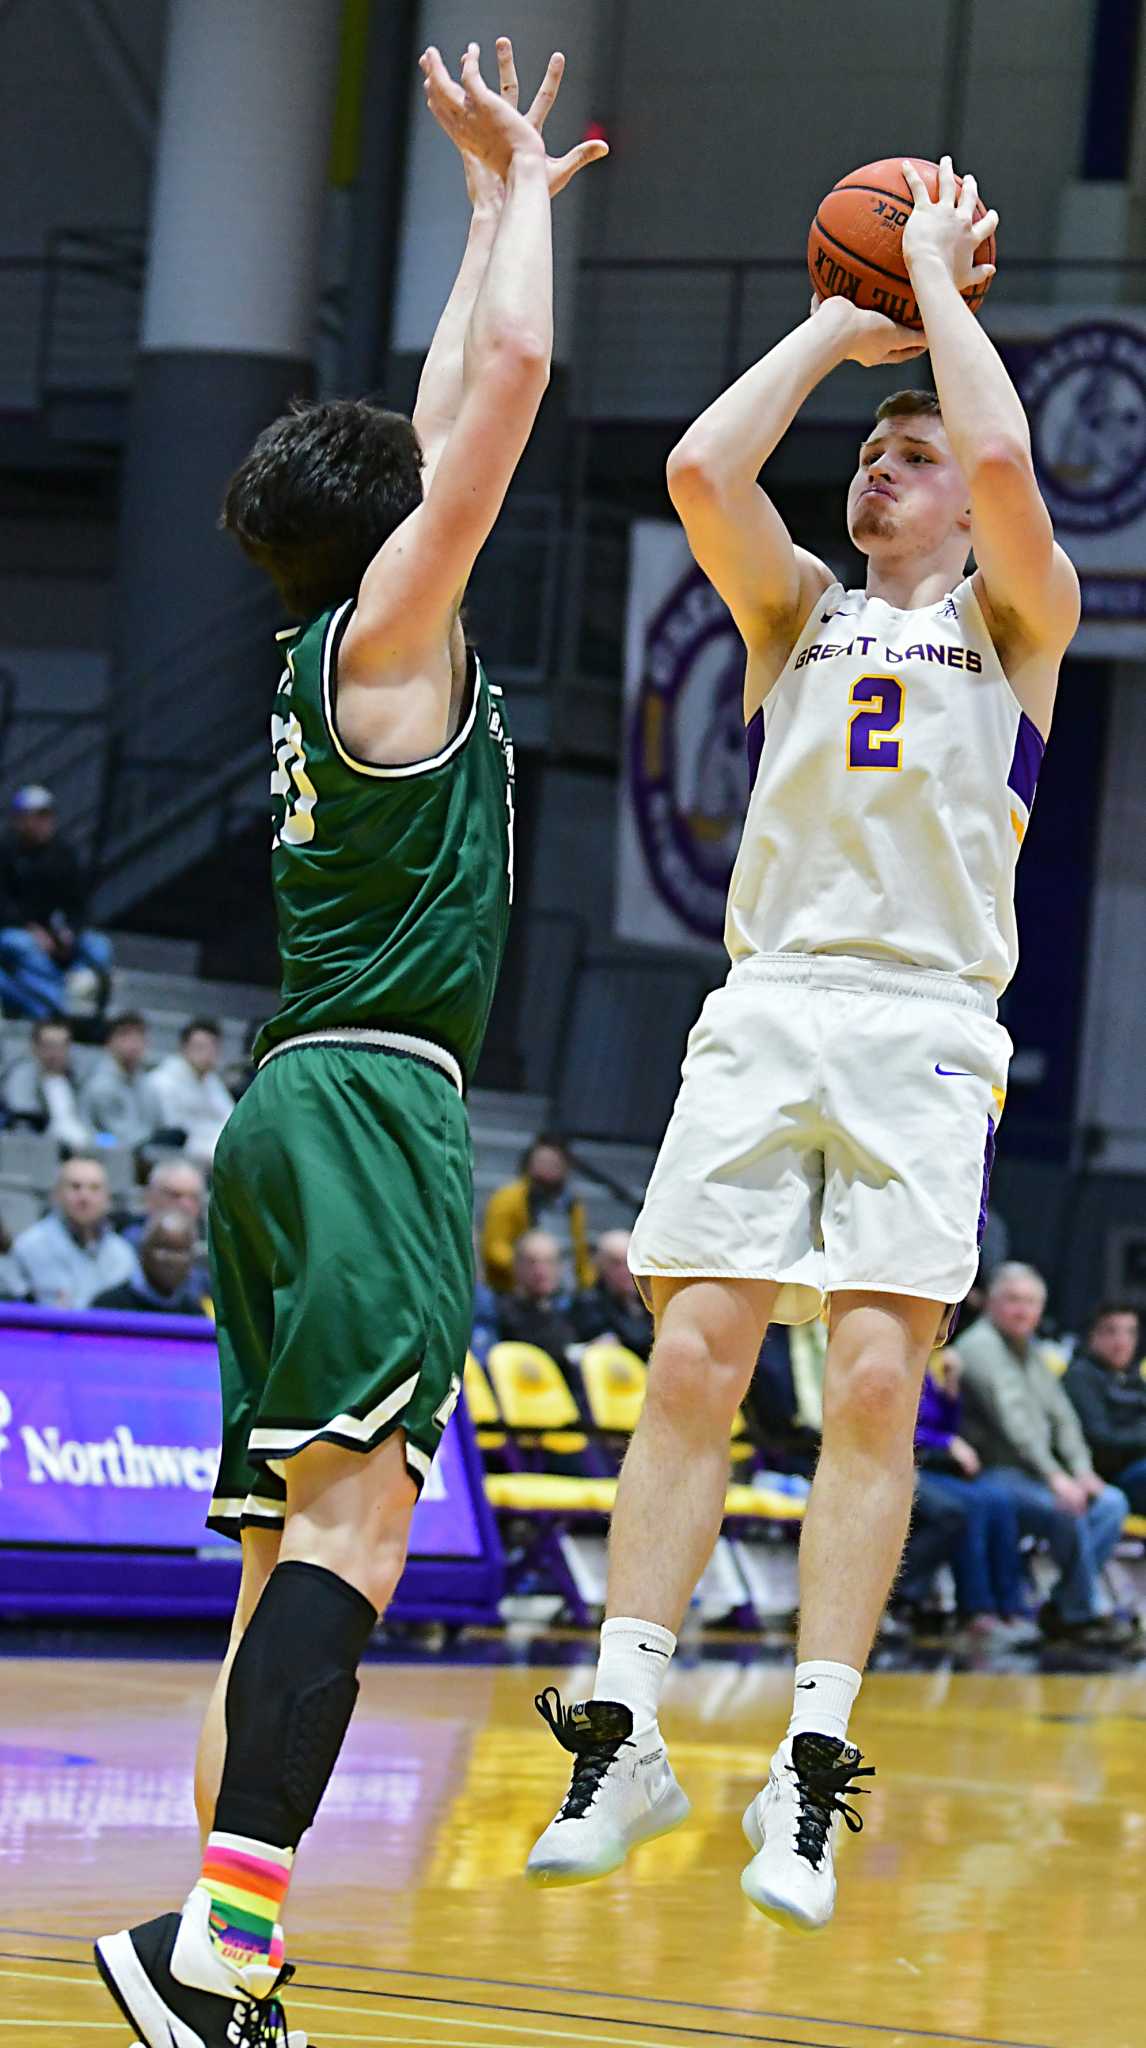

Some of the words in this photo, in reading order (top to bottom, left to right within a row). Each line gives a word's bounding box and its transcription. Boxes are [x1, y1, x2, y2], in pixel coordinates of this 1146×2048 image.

[872, 199, 909, 226] OCK
[795, 636, 876, 670] GREAT
[886, 643, 982, 673] DANES
[847, 673, 905, 771] 2
